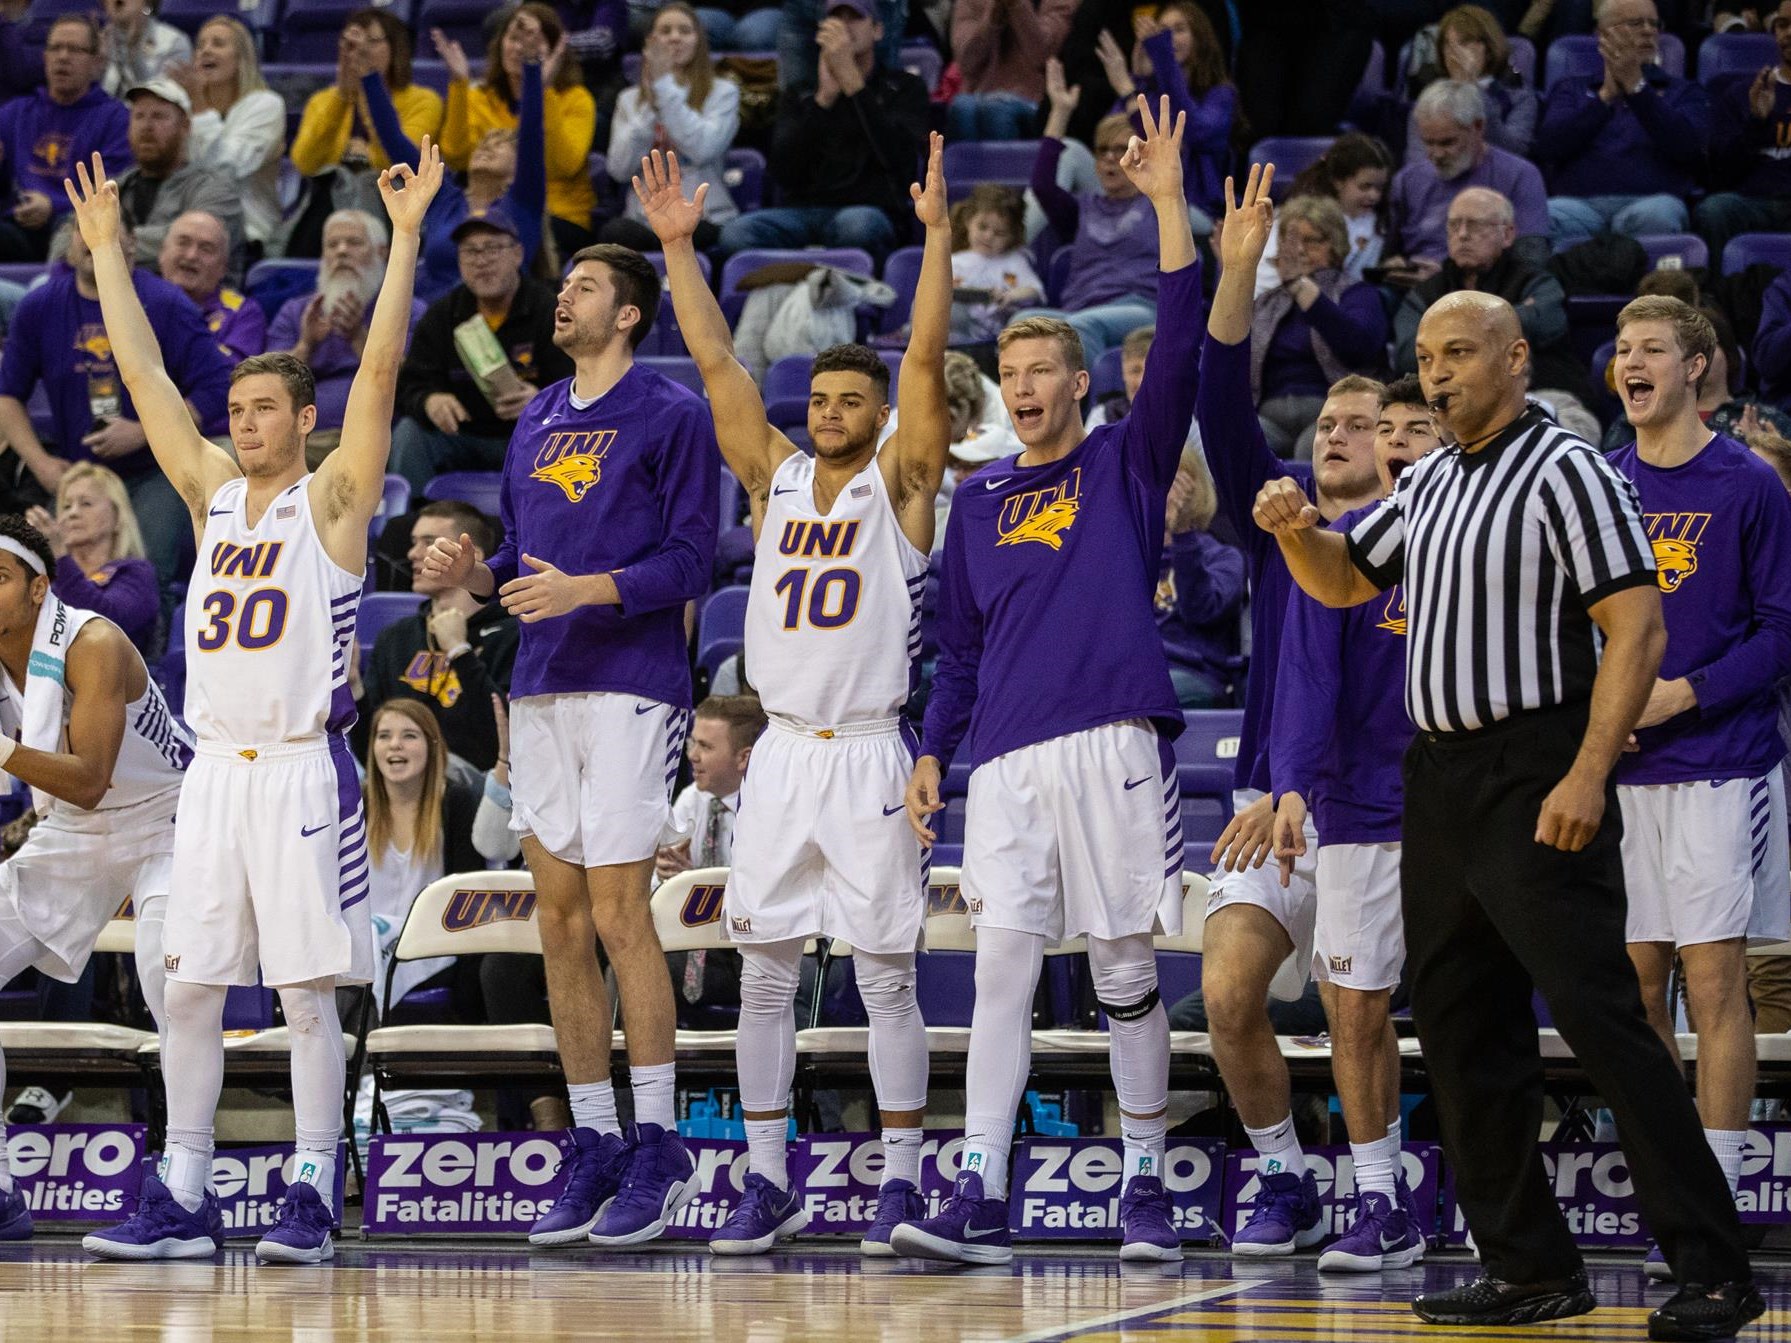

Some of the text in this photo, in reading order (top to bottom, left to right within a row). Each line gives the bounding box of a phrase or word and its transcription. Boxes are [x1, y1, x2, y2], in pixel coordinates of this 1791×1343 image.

[534, 430, 618, 471] UNI
[211, 541, 285, 579] UNI
[779, 519, 861, 559] UNI
[197, 585, 290, 653] 30
[774, 566, 863, 632] 10
[441, 889, 538, 933] UNI
[5, 1130, 136, 1177] ero
[378, 1139, 562, 1188] zero
[1024, 1145, 1212, 1193] zeo
[375, 1191, 556, 1223] Fatalities
